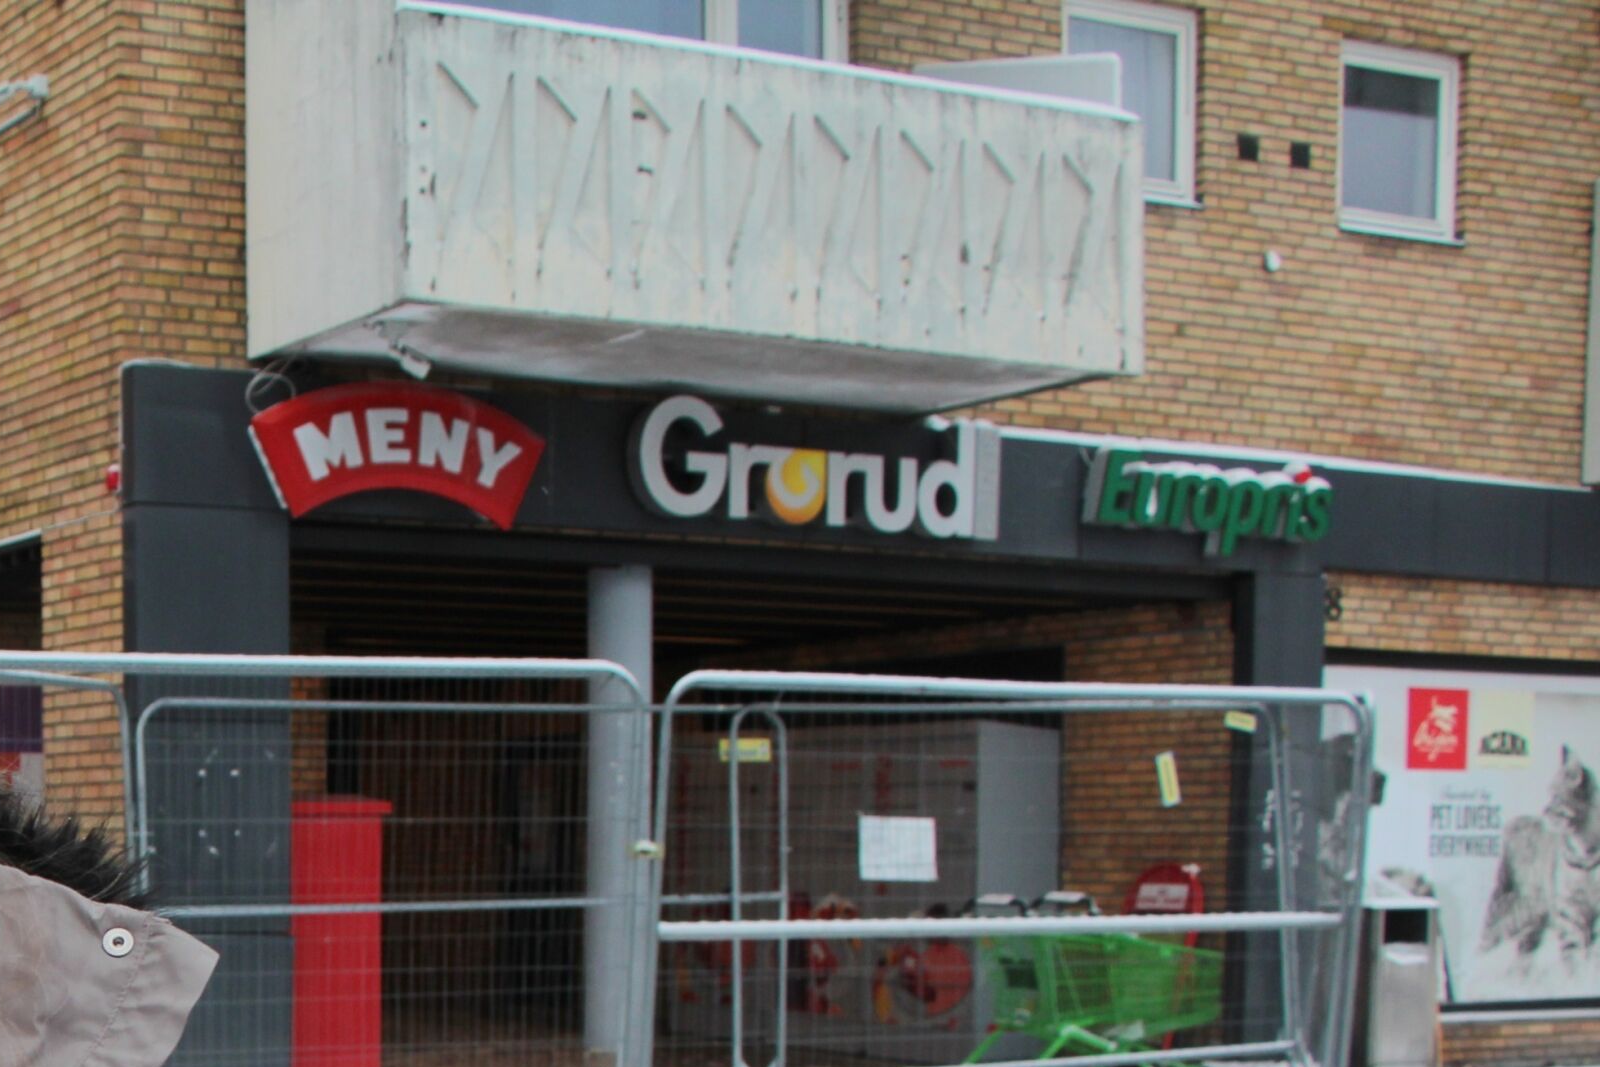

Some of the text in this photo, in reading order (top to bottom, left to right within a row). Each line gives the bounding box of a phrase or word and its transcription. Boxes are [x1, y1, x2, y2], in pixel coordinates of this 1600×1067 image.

[293, 407, 522, 489] MENY
[638, 394, 980, 540] Grorud
[1097, 447, 1333, 556] Europris
